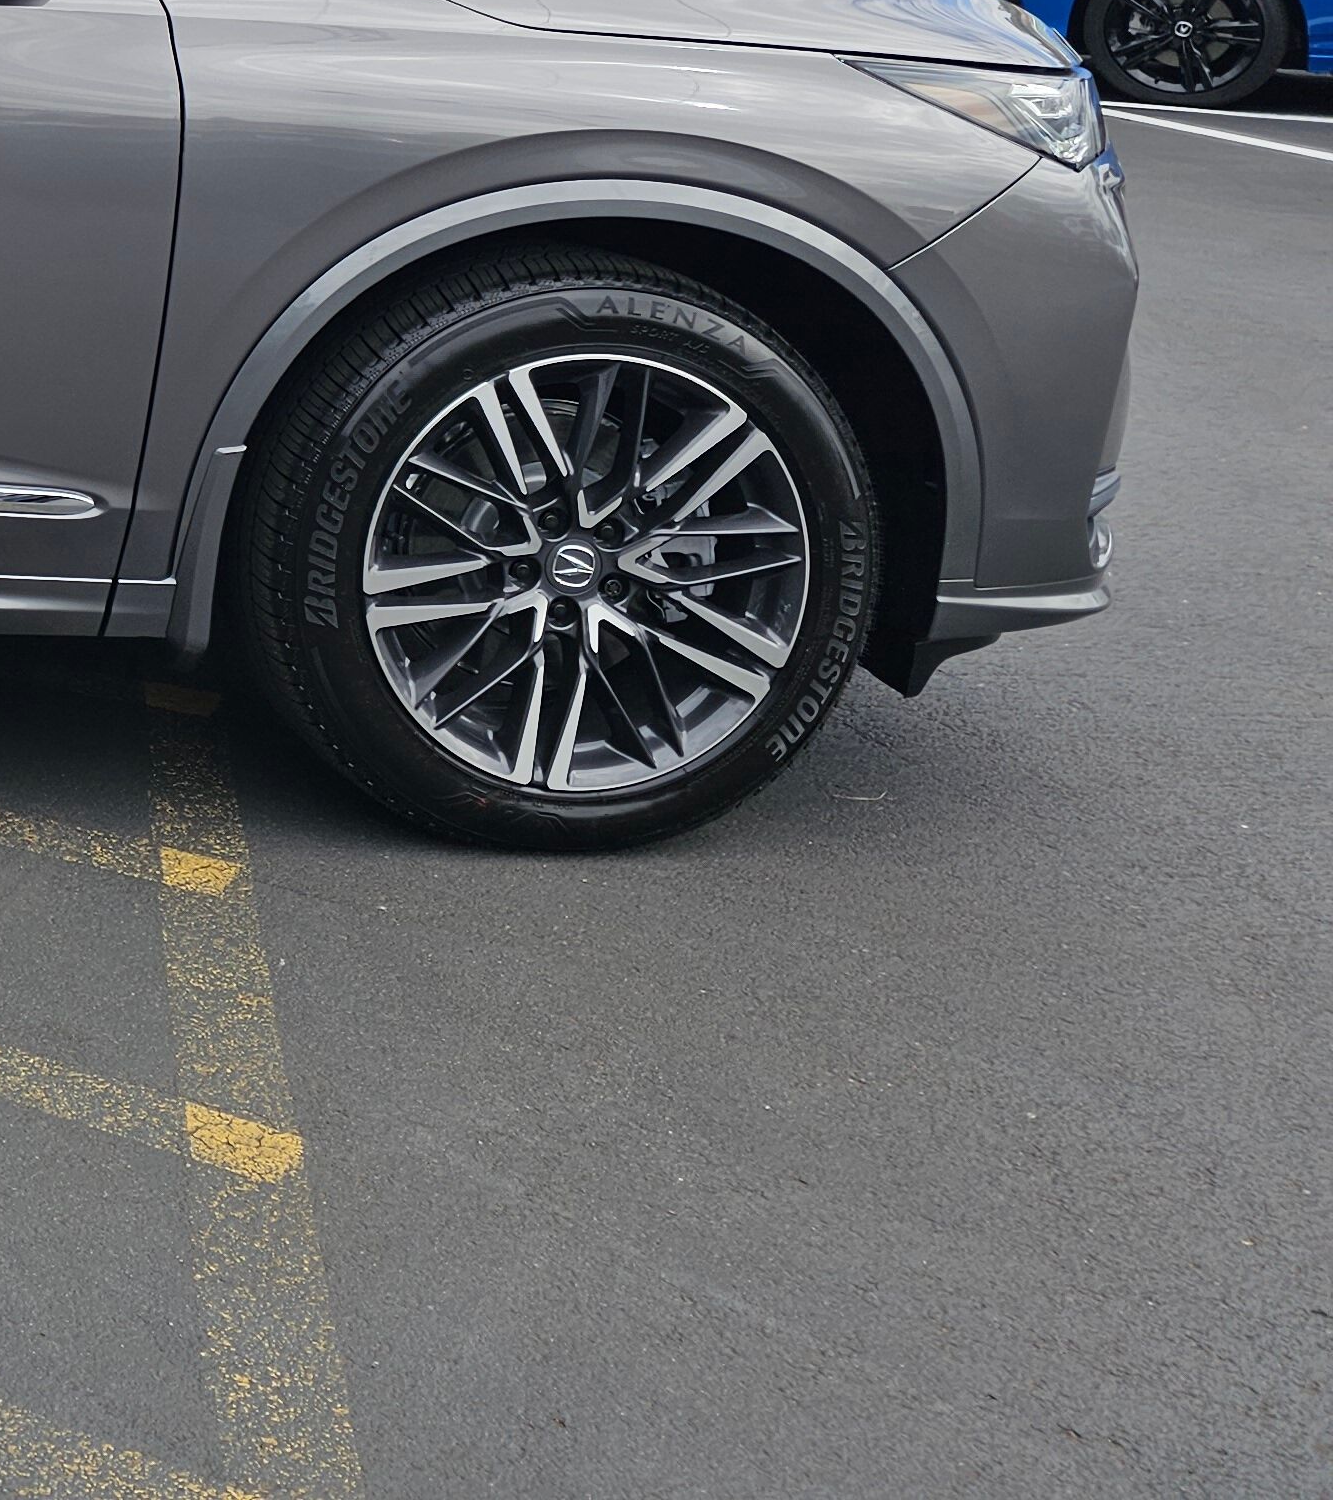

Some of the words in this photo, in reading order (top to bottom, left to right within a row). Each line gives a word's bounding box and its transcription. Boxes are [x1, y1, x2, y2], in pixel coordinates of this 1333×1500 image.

[595, 295, 747, 357] ALENZA
[303, 379, 413, 629] BRIDGESTONE
[764, 520, 868, 763] BRIDGESTONE
